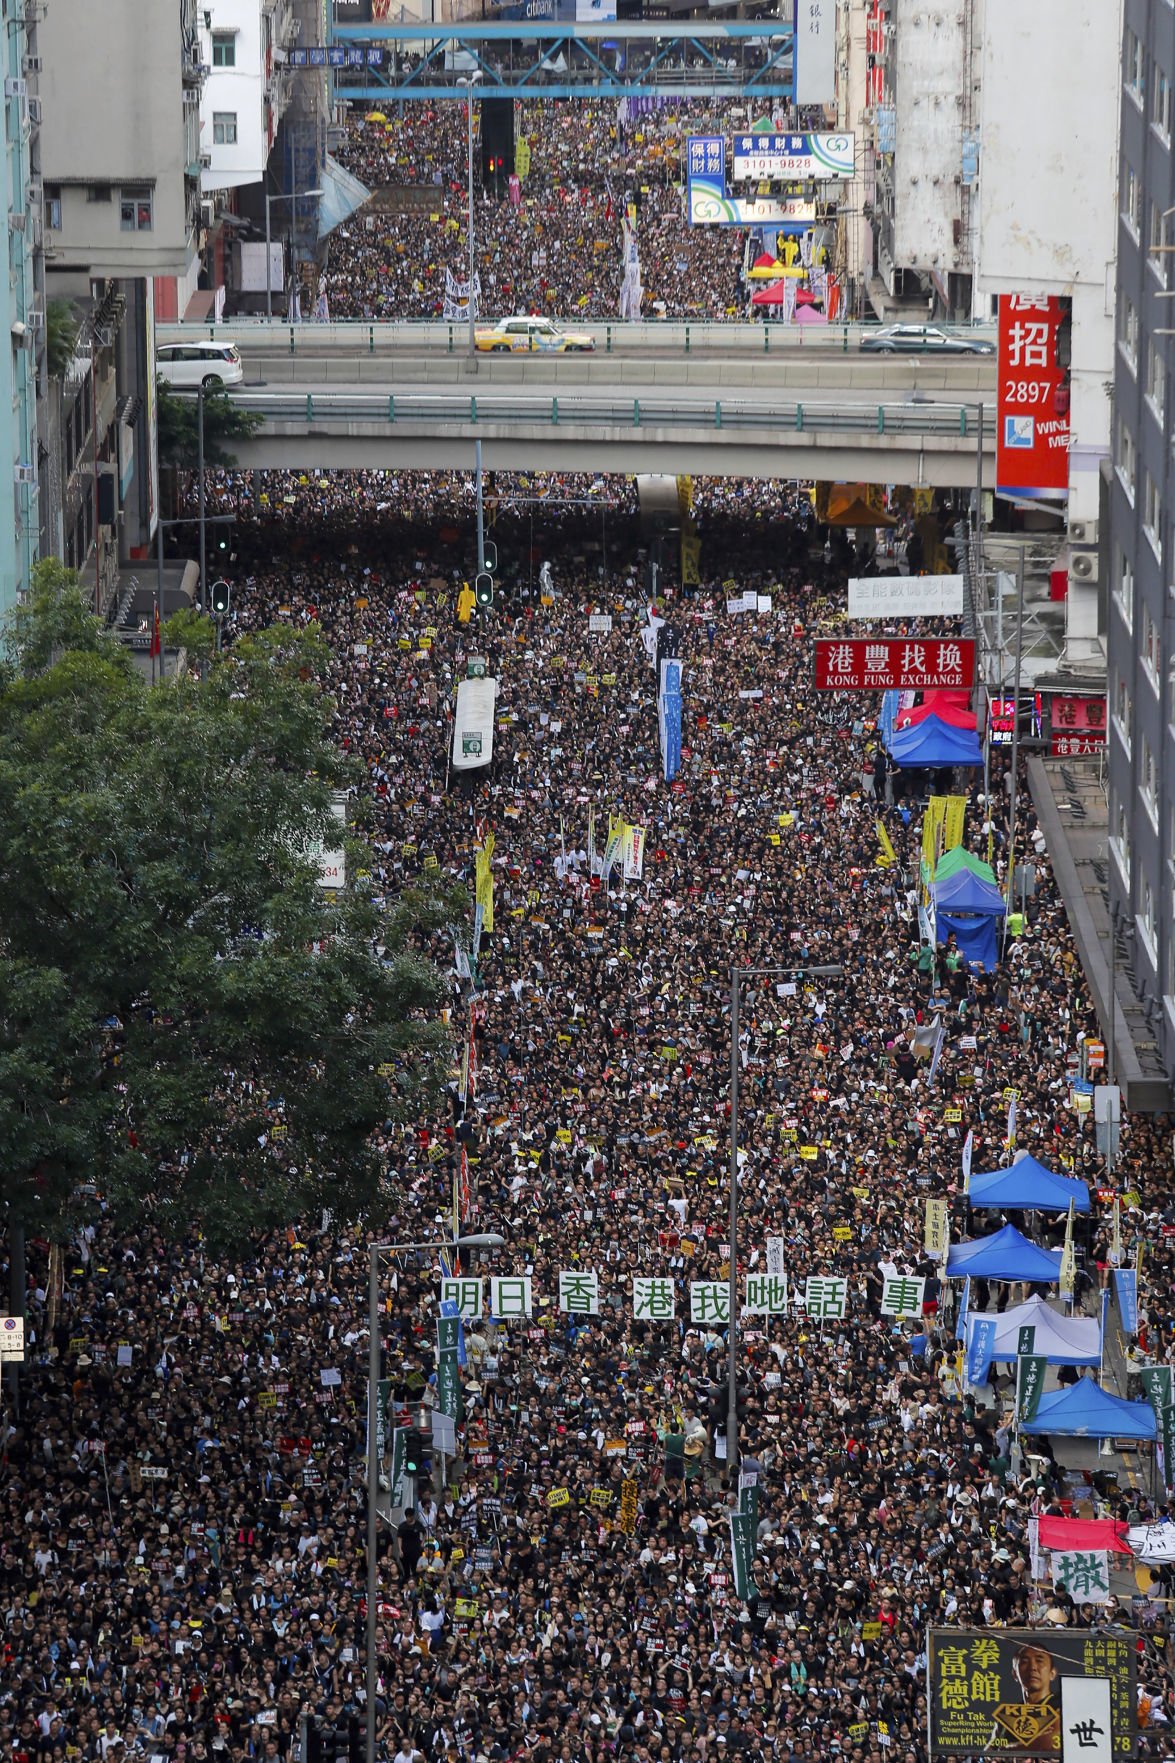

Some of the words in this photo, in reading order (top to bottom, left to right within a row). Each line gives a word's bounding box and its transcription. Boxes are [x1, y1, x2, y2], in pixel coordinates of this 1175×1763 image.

[742, 137, 803, 150] 保得財務
[743, 158, 811, 169] 3101-9828
[1005, 381, 1050, 403] 2897
[827, 643, 963, 673] 港豐找換
[826, 674, 859, 686] KONG
[863, 674, 894, 686] FUNG
[900, 673, 963, 686] EXCHANGE
[1058, 703, 1104, 727] 港豐
[1055, 1551, 1109, 1596] 撤
[938, 1646, 969, 1710] 富德
[970, 1639, 1001, 1703] 拳館
[950, 1711, 964, 1720] Fu
[966, 1711, 985, 1720] Tak
[1069, 1718, 1105, 1748] 世
